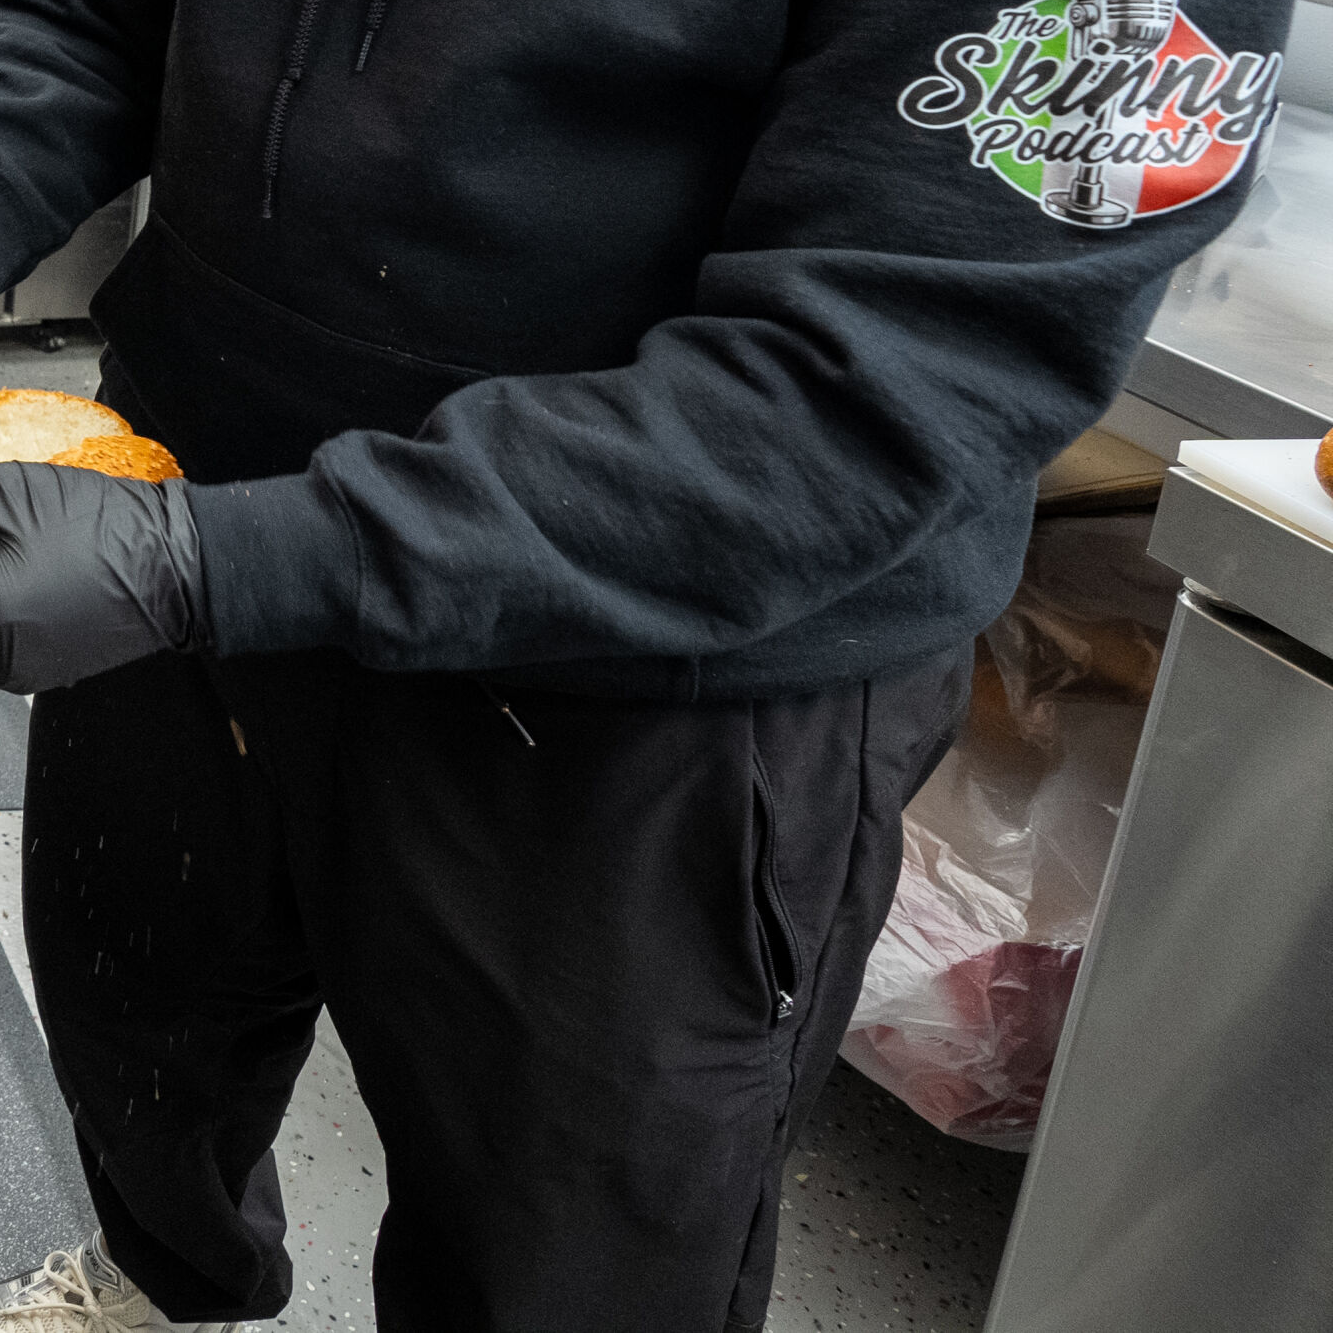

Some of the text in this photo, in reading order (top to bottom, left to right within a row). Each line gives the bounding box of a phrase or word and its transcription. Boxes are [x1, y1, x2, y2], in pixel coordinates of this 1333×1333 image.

[995, 10, 1063, 41] The
[899, 33, 1283, 144] Skinny
[971, 118, 1209, 167] Podcast
